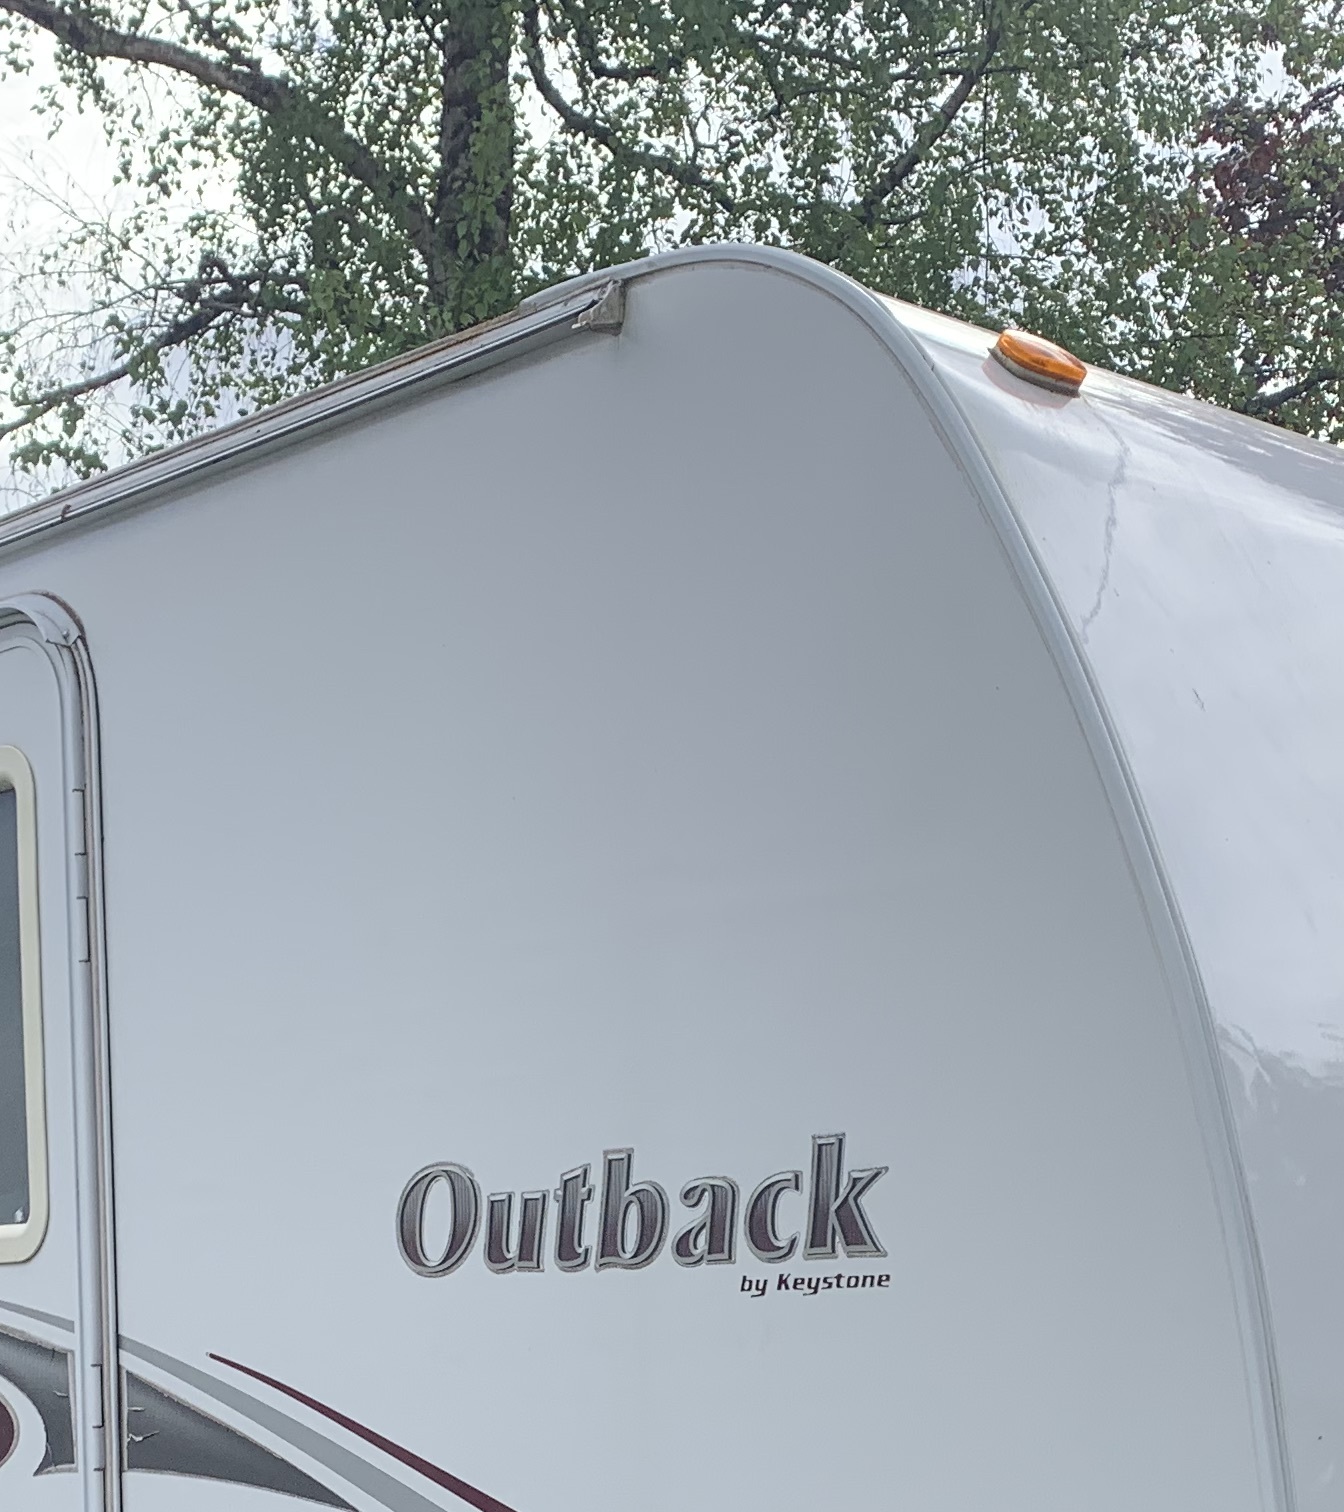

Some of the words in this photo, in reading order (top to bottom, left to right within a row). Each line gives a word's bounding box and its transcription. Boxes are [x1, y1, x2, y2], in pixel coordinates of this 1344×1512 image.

[396, 1132, 889, 1278] Outback
[740, 1275, 768, 1297] by
[777, 1272, 891, 1296] Keystone
